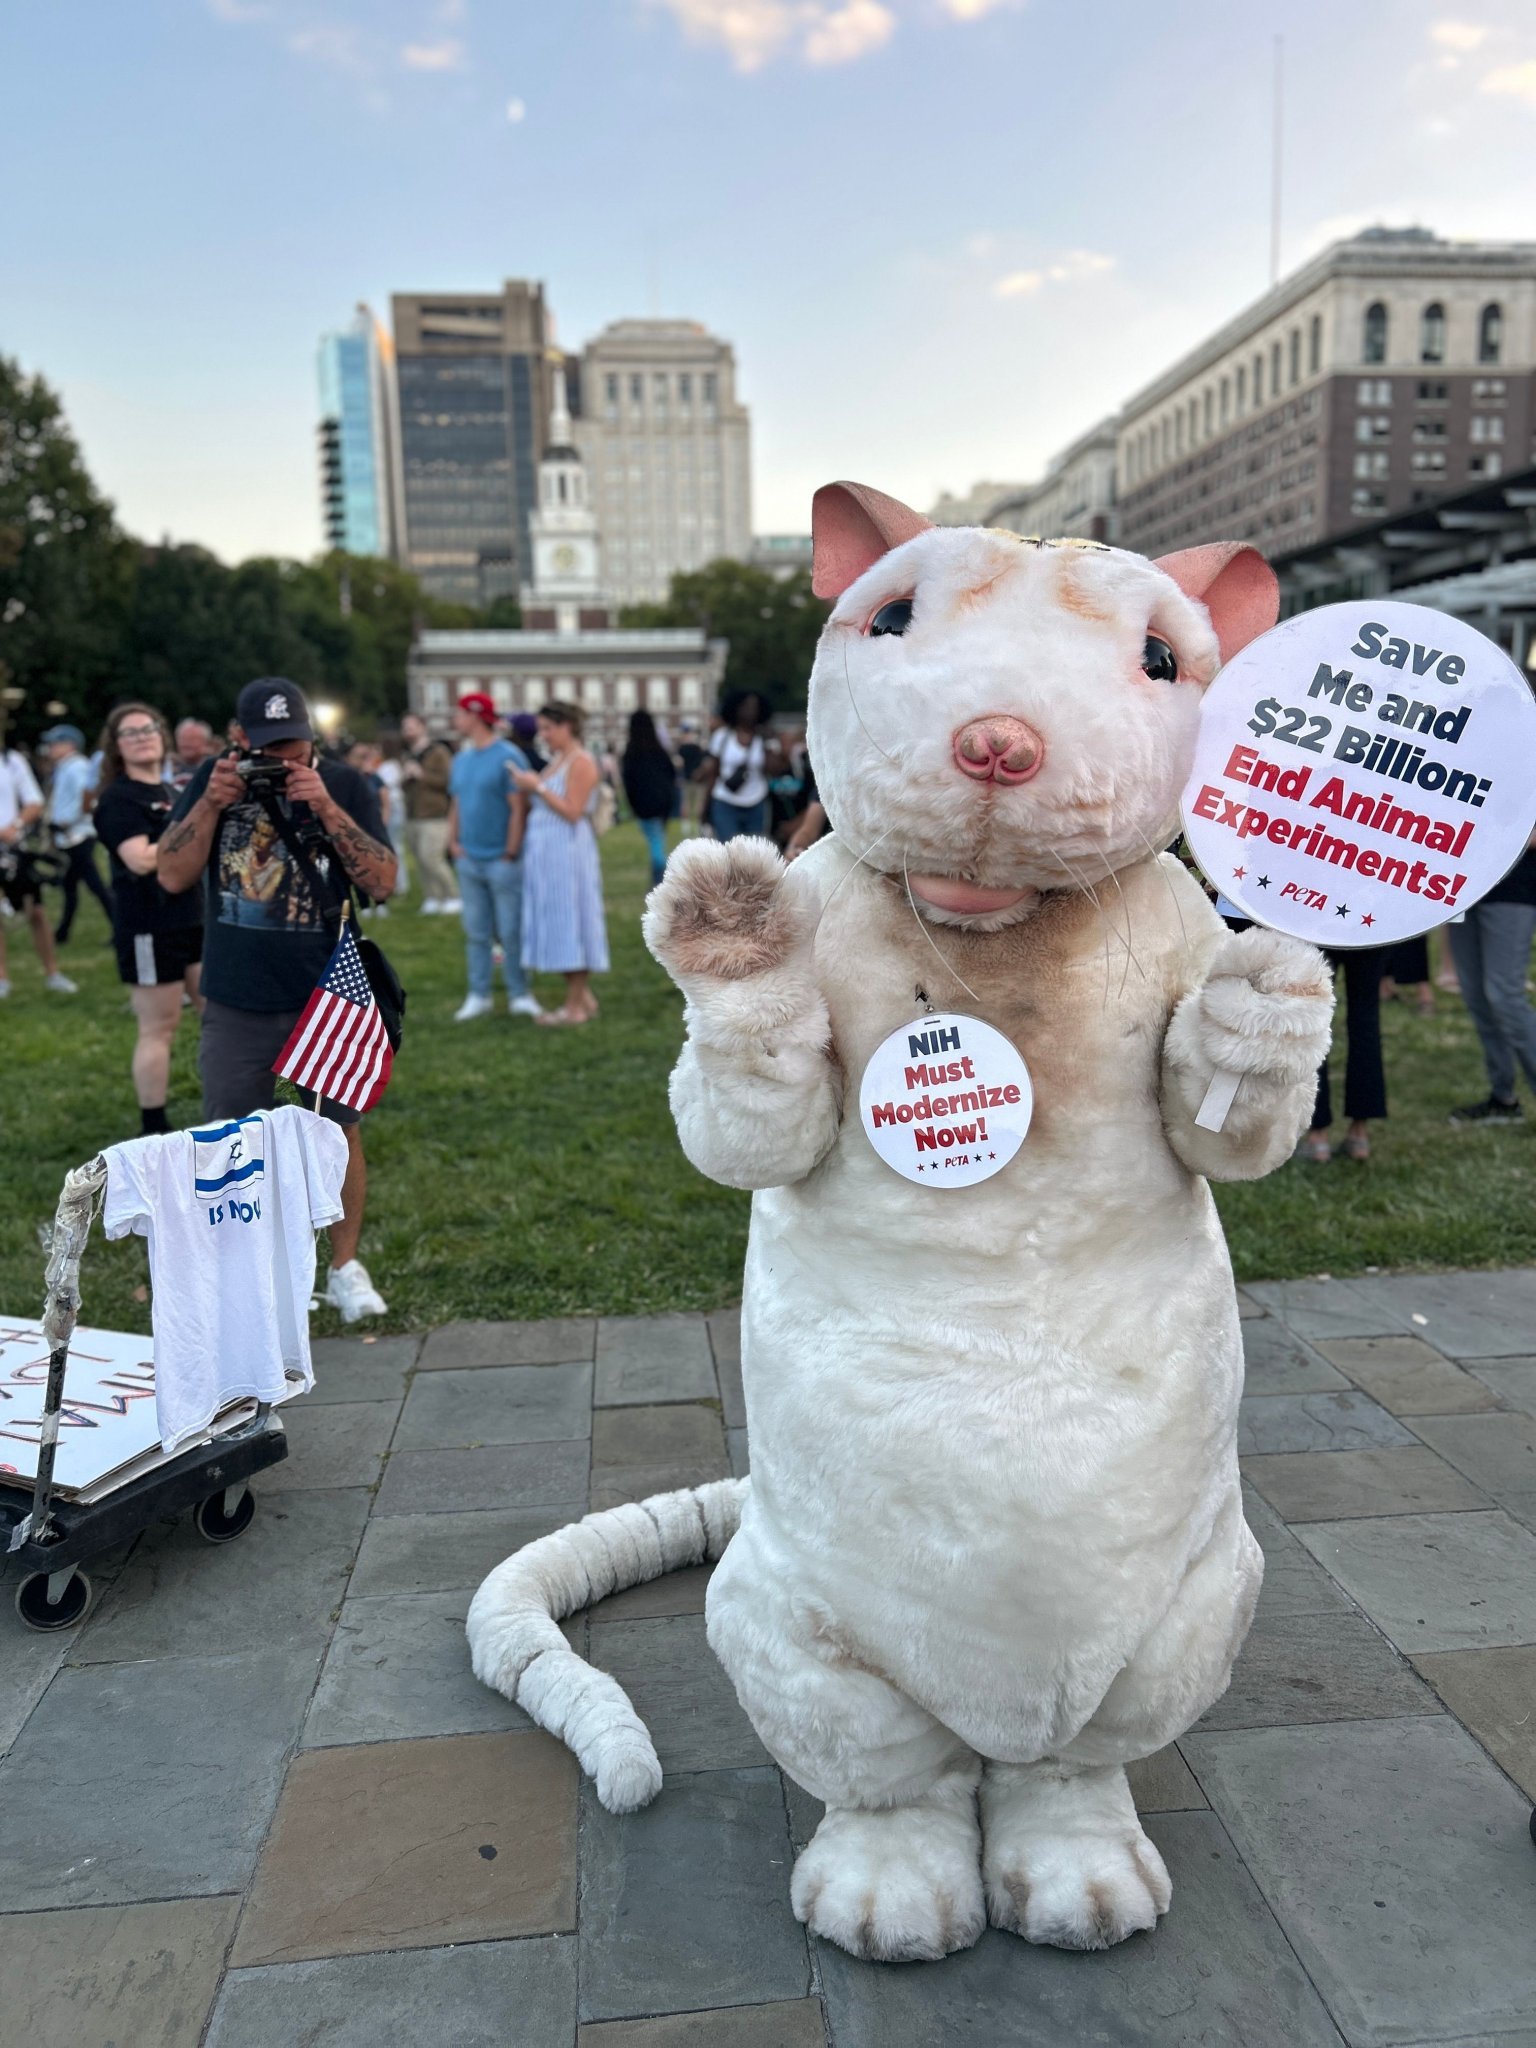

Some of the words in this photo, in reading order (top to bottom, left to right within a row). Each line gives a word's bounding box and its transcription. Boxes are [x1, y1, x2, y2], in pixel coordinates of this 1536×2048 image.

[1350, 621, 1466, 685] Save
[1307, 663, 1374, 712] Me
[1378, 693, 1473, 744] and
[1246, 697, 1333, 754] $22
[1333, 725, 1493, 808] Billion:
[1222, 743, 1313, 802] End
[1309, 776, 1475, 858] Animal
[1191, 784, 1468, 907] Experiments!
[907, 1026, 961, 1058] NIH
[904, 1056, 975, 1090] Must
[871, 1084, 1021, 1128] Modernize
[914, 1117, 989, 1152] Now!
[208, 1204, 224, 1226] IS
